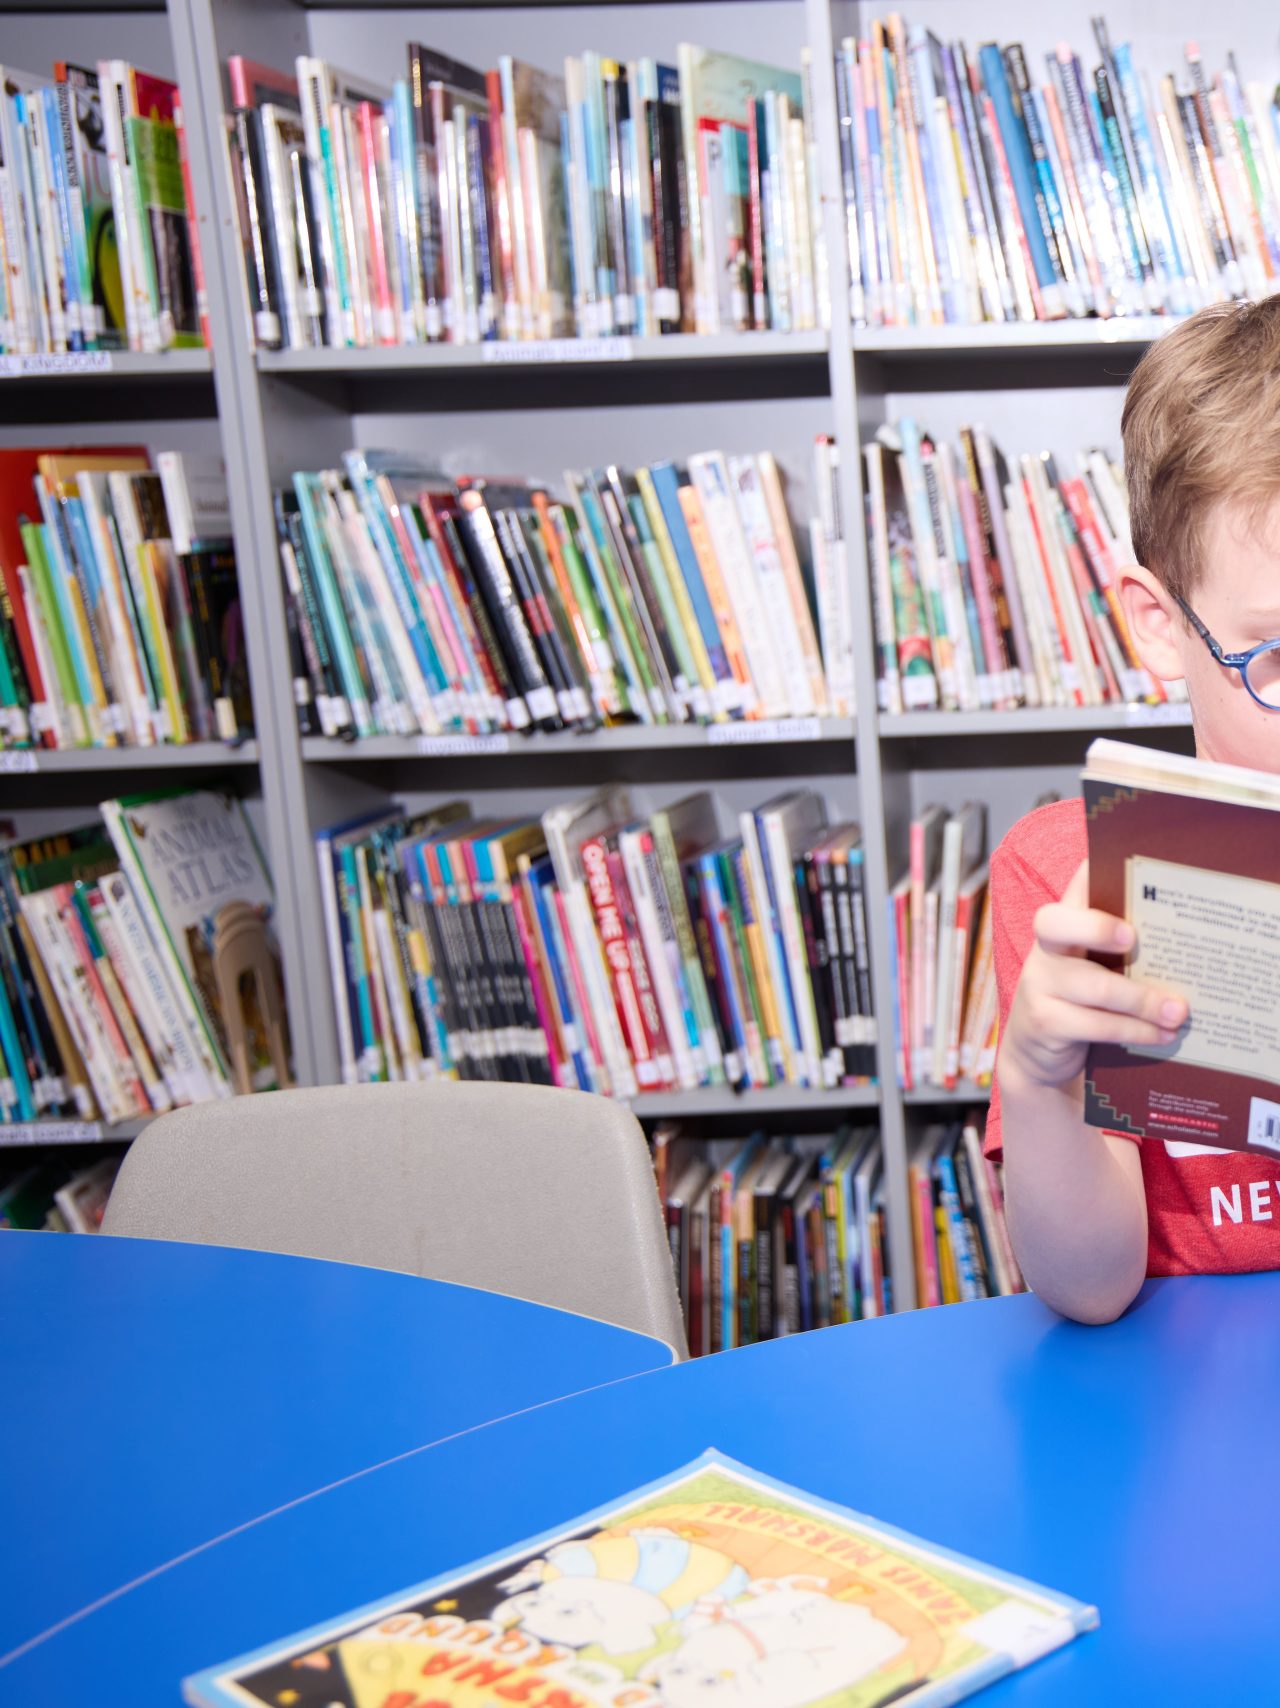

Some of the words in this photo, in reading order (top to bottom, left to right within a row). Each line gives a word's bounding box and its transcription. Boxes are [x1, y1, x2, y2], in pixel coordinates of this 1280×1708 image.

[167, 850, 253, 905] ATLAS
[583, 843, 615, 908] OPEN
[598, 905, 624, 940] ME
[606, 940, 631, 972] UP
[704, 1502, 885, 1568] MARSHALL
